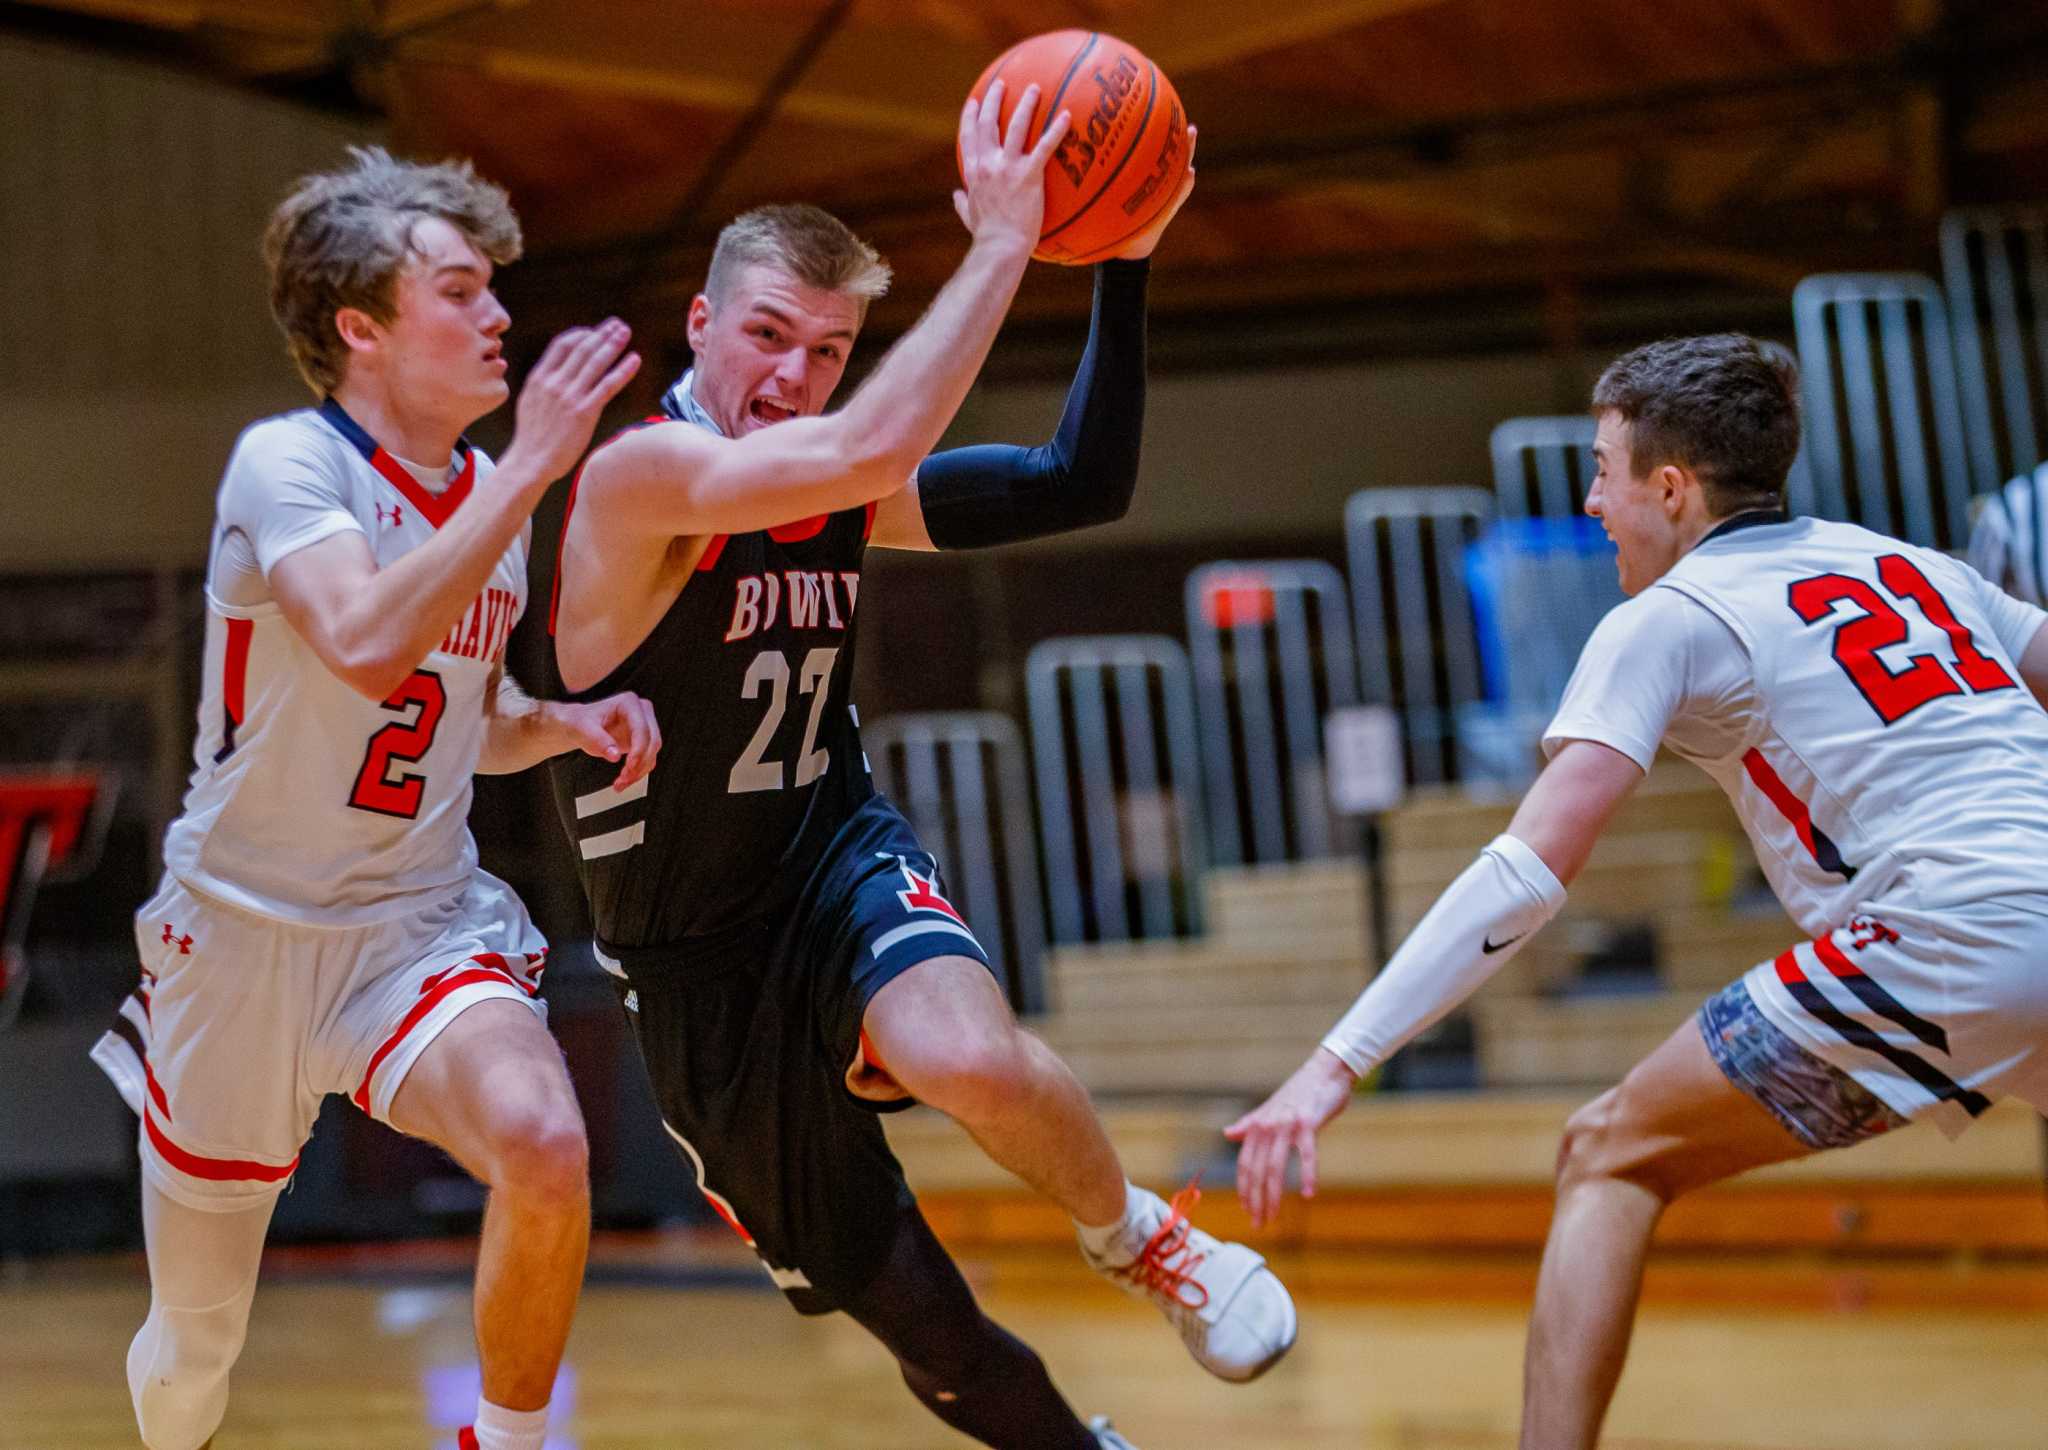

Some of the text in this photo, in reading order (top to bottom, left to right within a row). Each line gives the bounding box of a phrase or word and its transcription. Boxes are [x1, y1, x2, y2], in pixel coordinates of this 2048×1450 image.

[1055, 53, 1139, 188] Baden
[1787, 553, 2020, 728] 21
[346, 667, 447, 820] 2
[727, 647, 840, 794] 22
